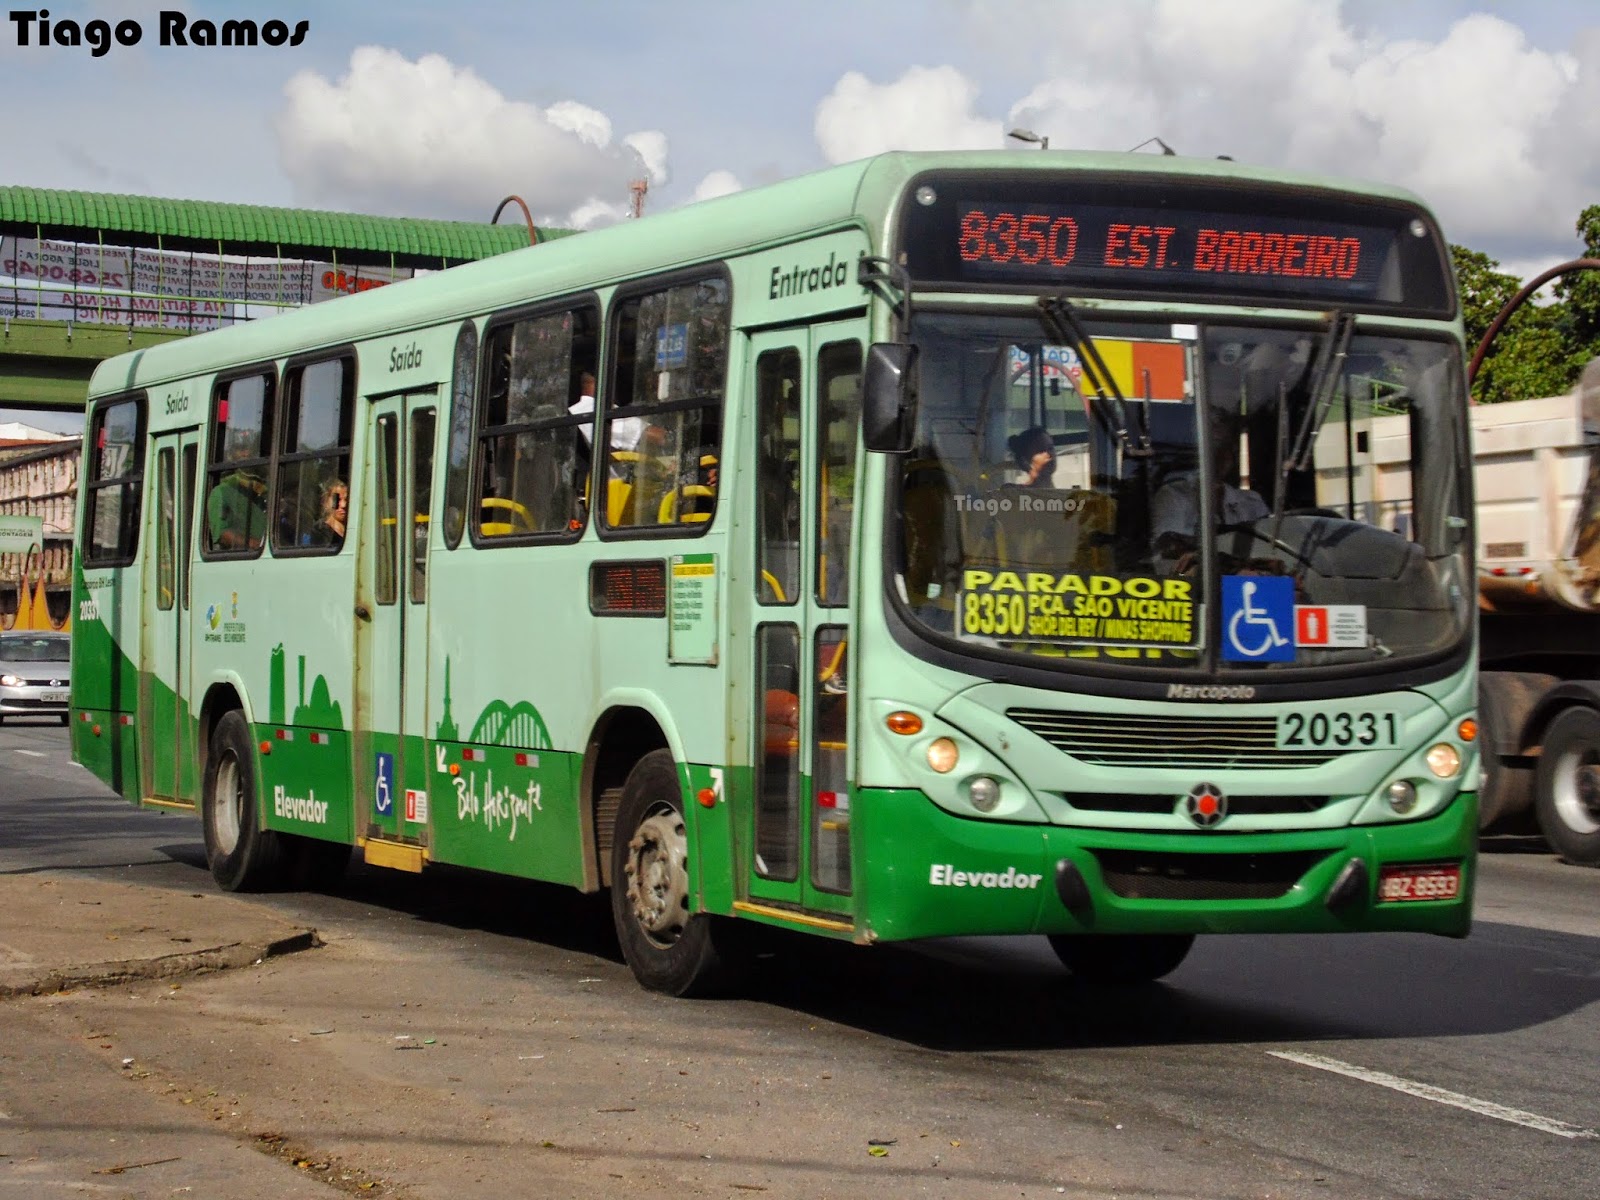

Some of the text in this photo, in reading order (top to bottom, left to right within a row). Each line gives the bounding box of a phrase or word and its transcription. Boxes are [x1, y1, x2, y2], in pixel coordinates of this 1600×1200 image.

[958, 210, 1361, 279] 8350 EST. BARREIRO
[769, 251, 848, 300] Entrada
[388, 341, 423, 373] Saída
[165, 389, 189, 416] Saída
[963, 569, 1192, 600] PARADOR
[964, 592, 1026, 635] 8350
[1117, 598, 1193, 622] VICENTE
[1166, 683, 1256, 700] Marcopolo
[1282, 712, 1397, 746] 20331
[273, 785, 328, 824] Elevador
[929, 863, 1043, 889] Elevador
